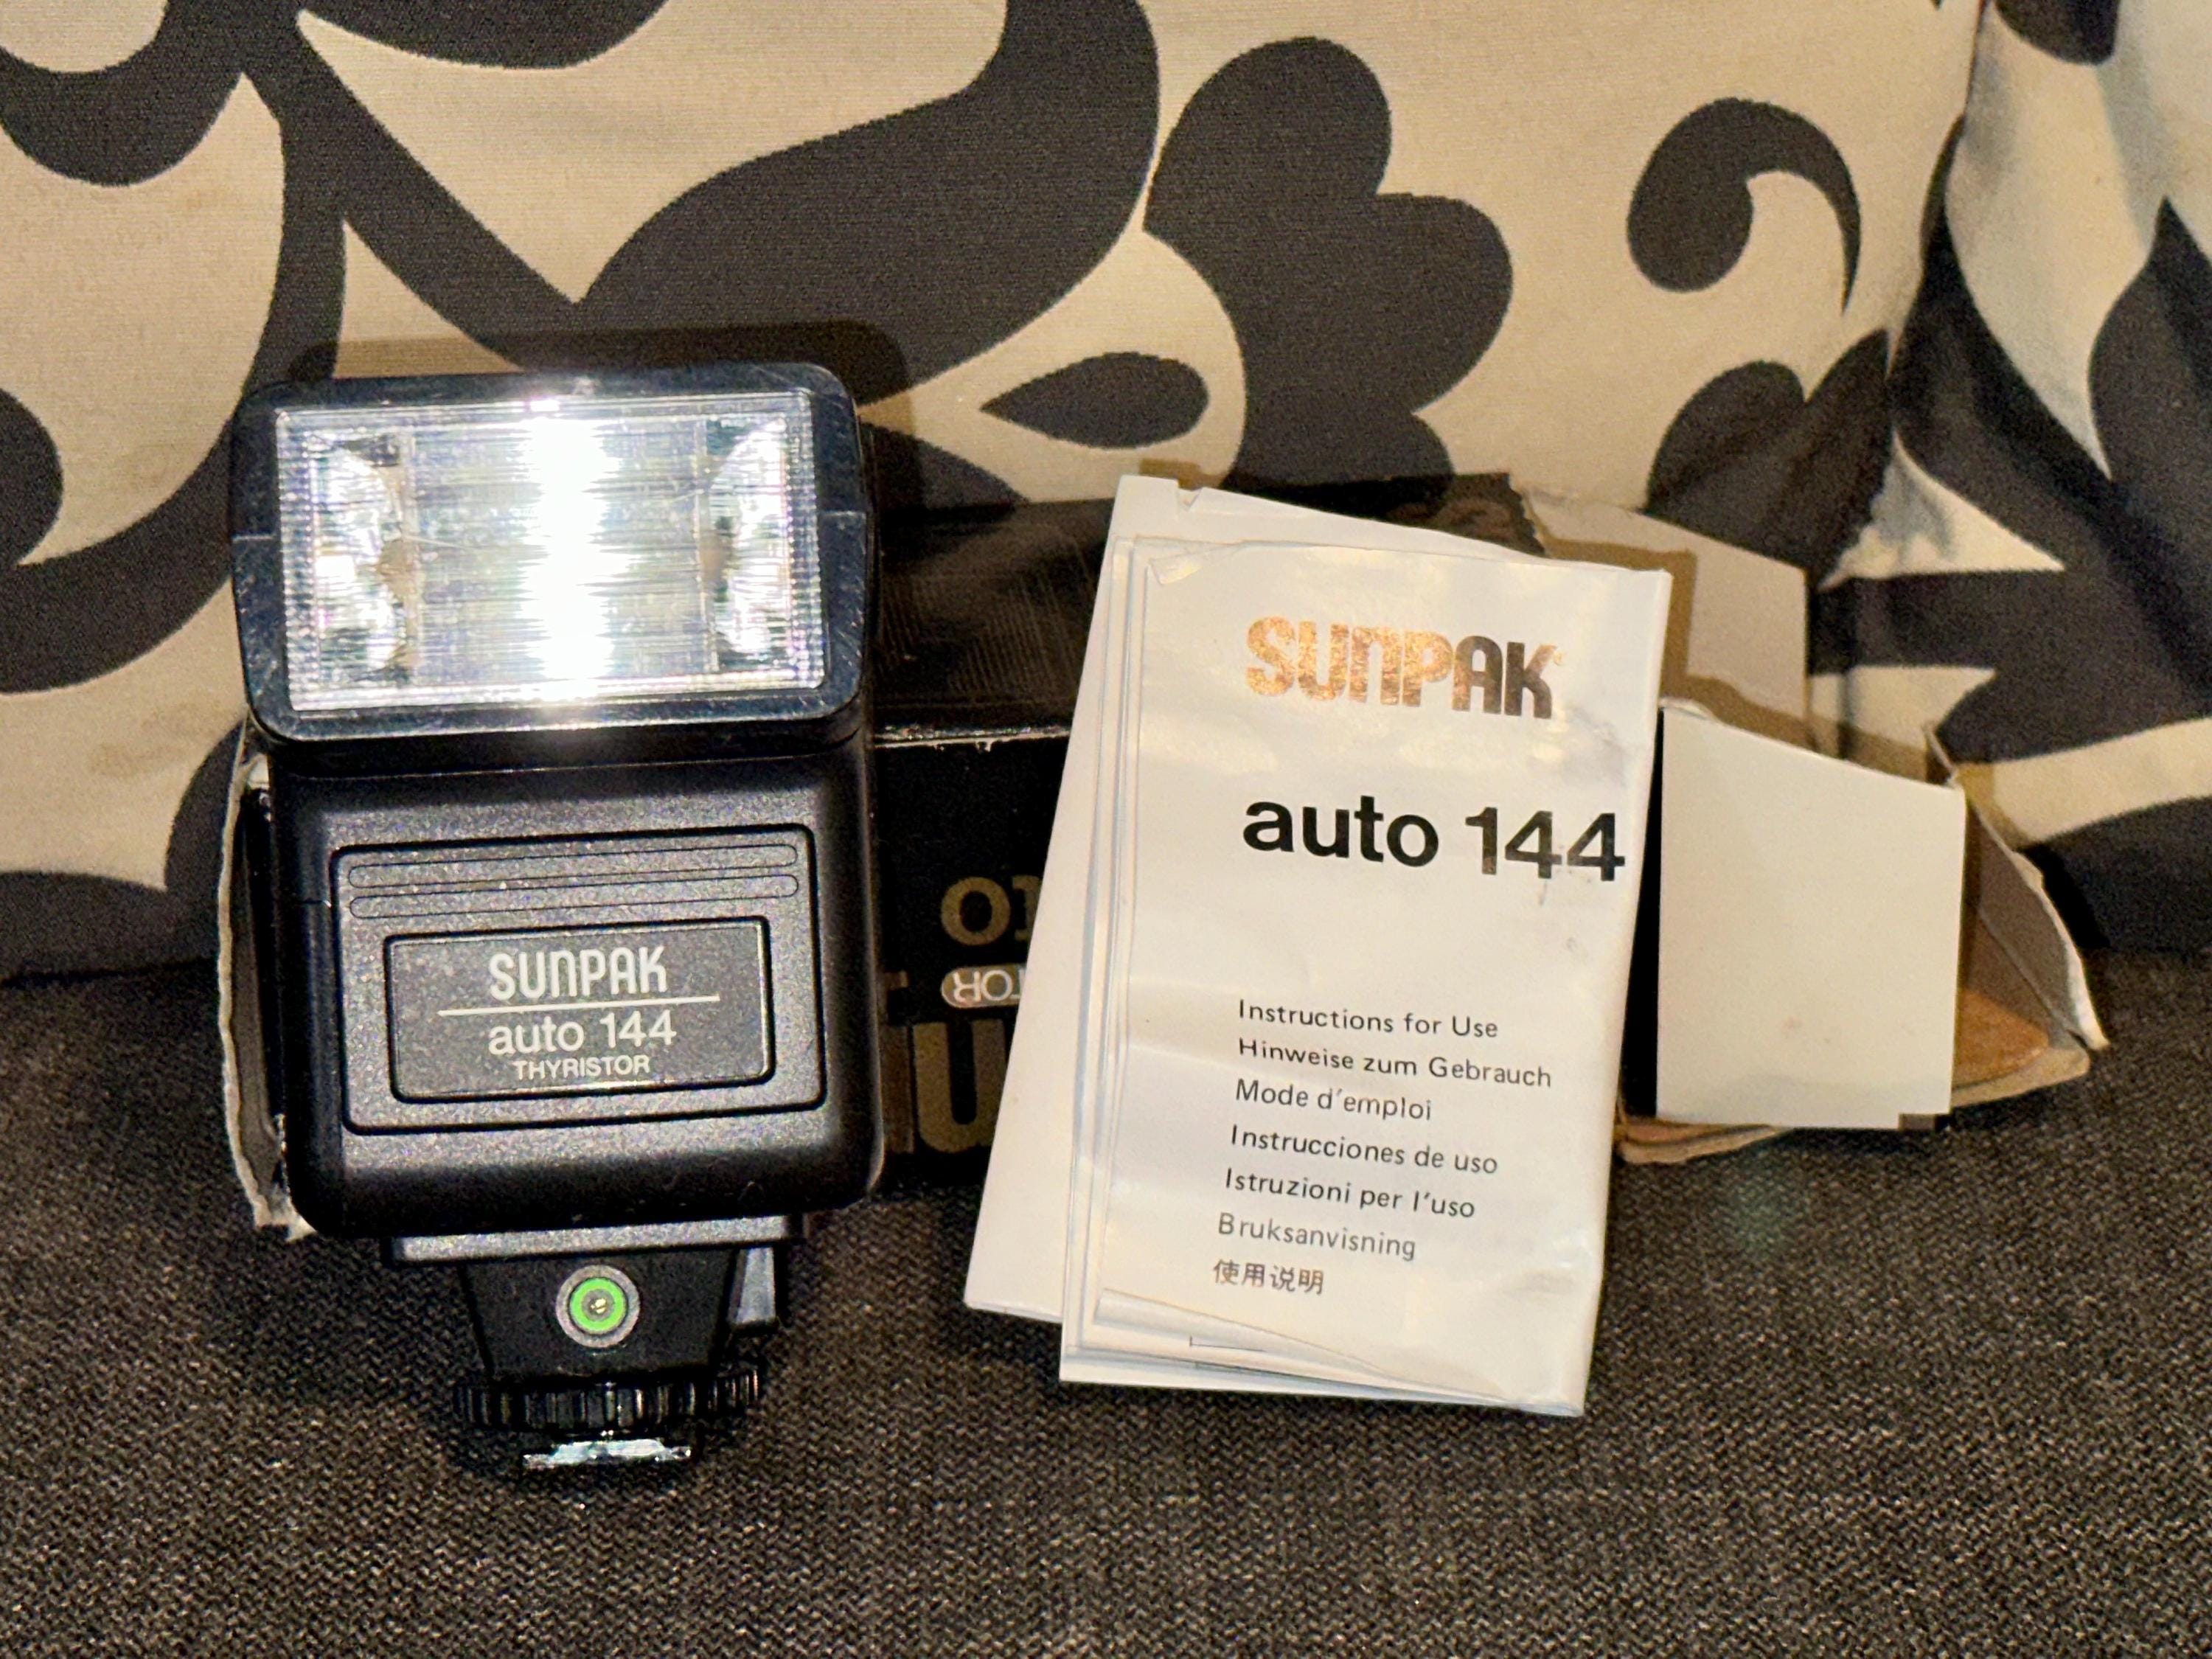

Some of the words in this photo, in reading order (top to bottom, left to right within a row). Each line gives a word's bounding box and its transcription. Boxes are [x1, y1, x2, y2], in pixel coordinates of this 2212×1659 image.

[1246, 616, 1559, 720] SUNPAK
[1242, 795, 1439, 867] auto
[1465, 807, 1626, 882] 144
[489, 945, 667, 1000] SUNPAK
[488, 1016, 585, 1055] auto
[599, 1009, 677, 1048] 144
[1239, 999, 1394, 1033] Instructions
[1404, 1012, 1441, 1034] for
[1452, 1015, 1498, 1037] Use
[512, 1054, 650, 1080] THYRISTOR
[1239, 1037, 1354, 1069] Hinweise
[1363, 1057, 1417, 1076] zum
[1428, 1057, 1551, 1088] Gebrauch
[1236, 1078, 1309, 1107] Mode
[1318, 1088, 1430, 1120] d'emploi
[1231, 1124, 1405, 1165] Instrucciones
[1414, 1146, 1444, 1168] de
[1454, 1155, 1498, 1174] uso
[1225, 1167, 1350, 1203] Istruzioni
[1360, 1190, 1402, 1209] per
[1413, 1191, 1475, 1218] l'uso
[1218, 1212, 1416, 1262] Bruksanvisning
[1213, 1259, 1324, 1295] 使用说明
